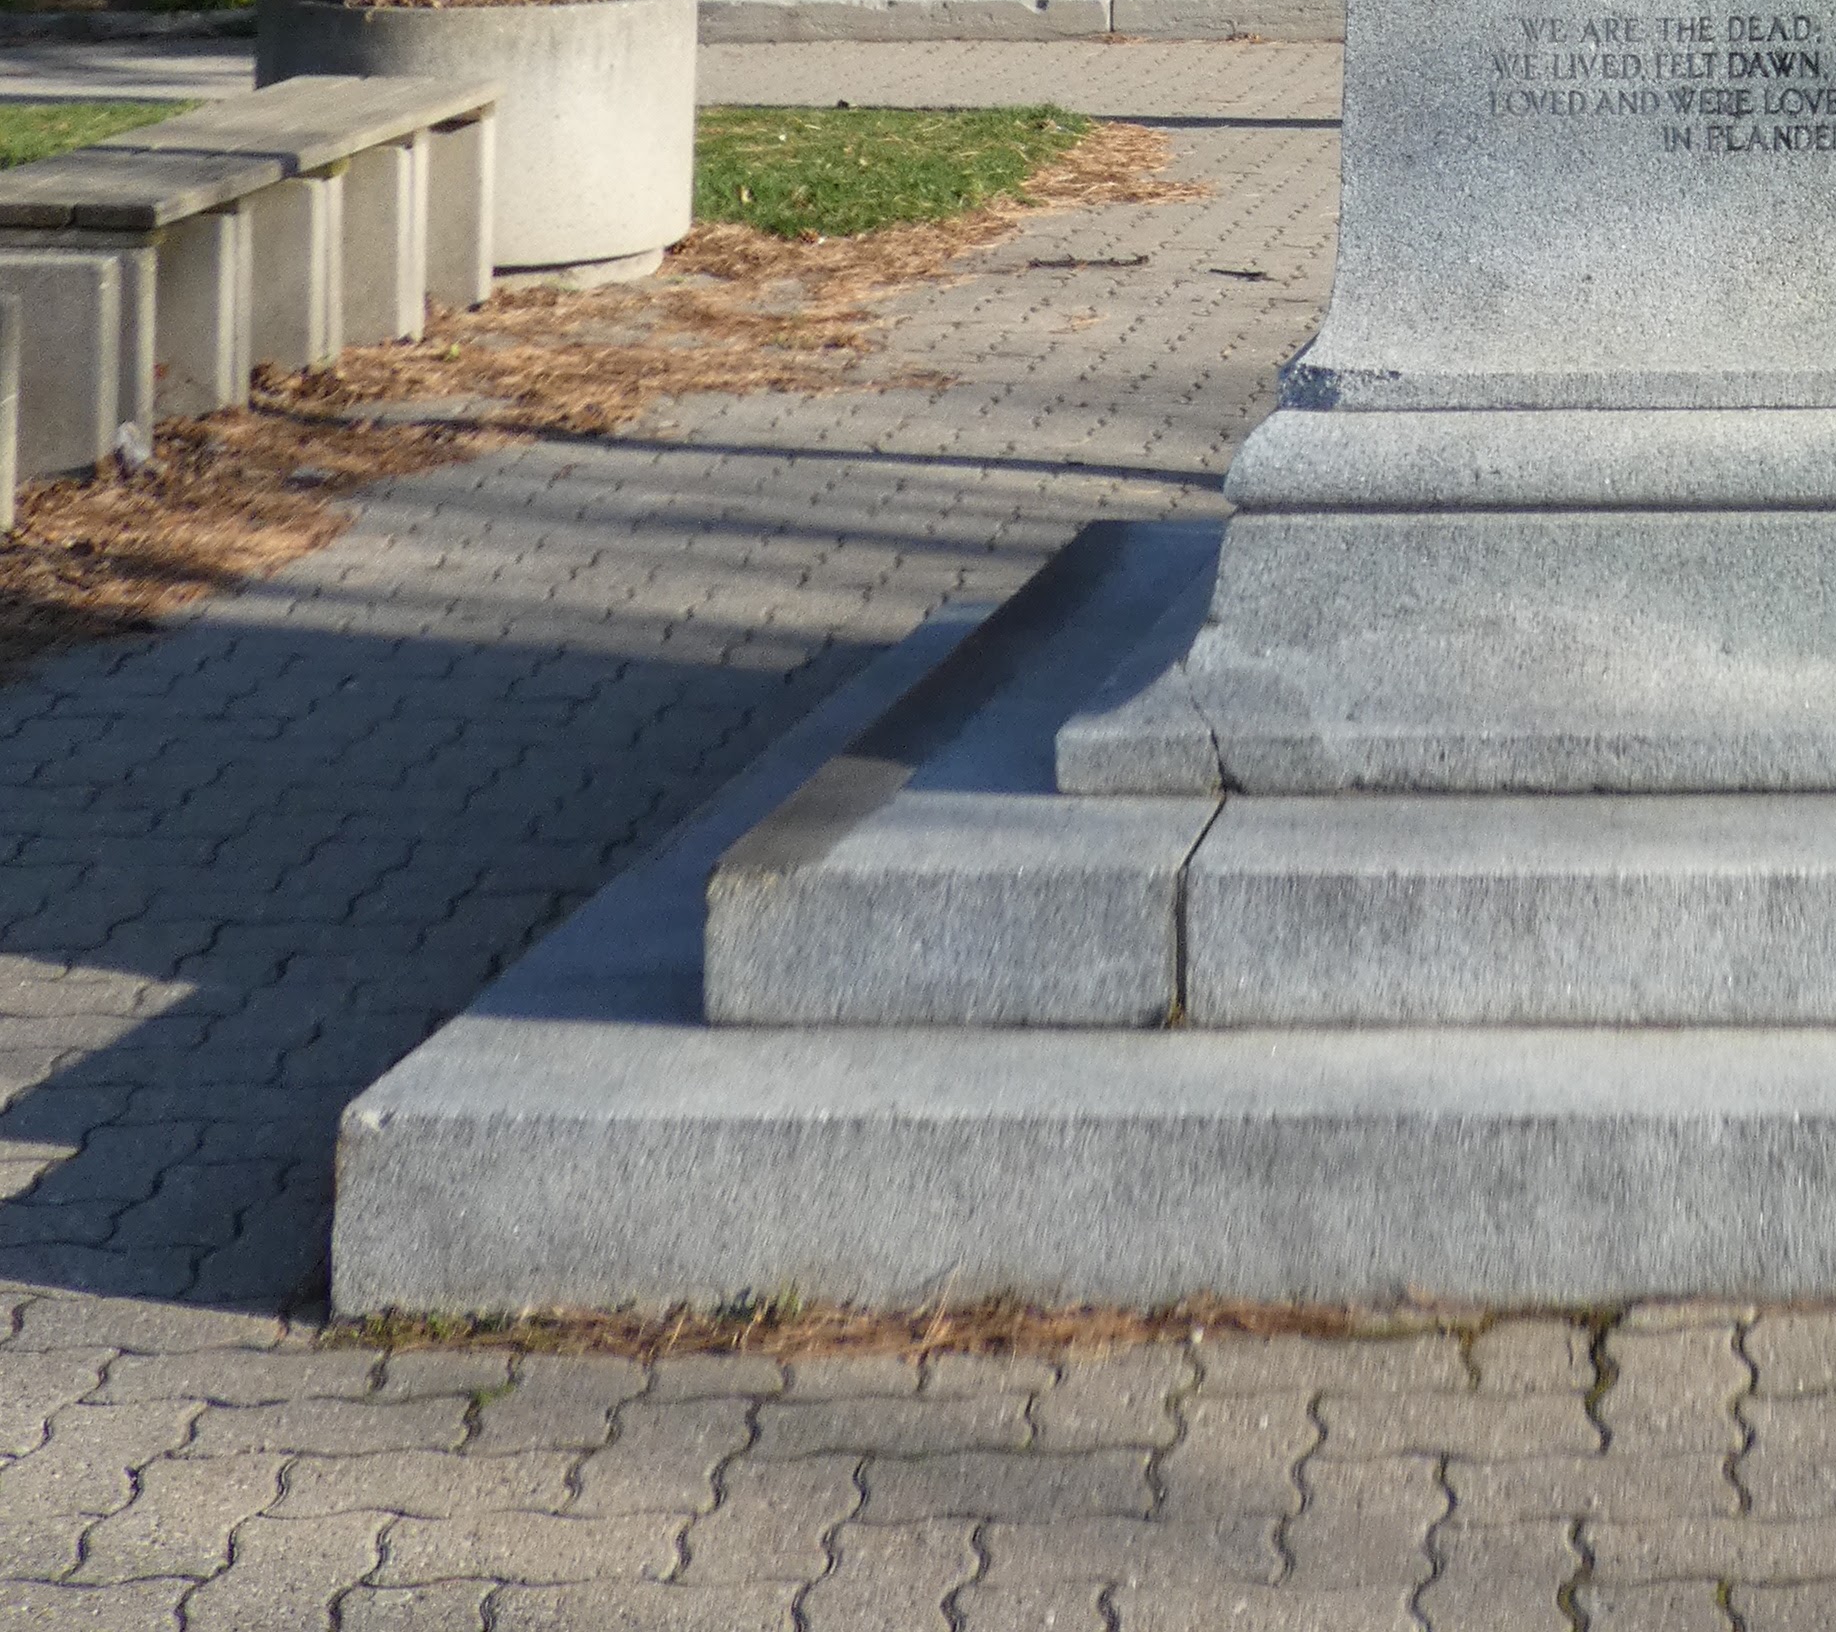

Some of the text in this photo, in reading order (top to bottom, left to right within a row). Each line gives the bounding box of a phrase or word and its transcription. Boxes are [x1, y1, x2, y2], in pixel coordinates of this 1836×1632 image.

[1580, 16, 1645, 46] ARE
[1655, 16, 1717, 43] THE
[1493, 52, 1540, 81] WE
[1655, 52, 1718, 80] FELT
[1488, 88, 1588, 117] LOVED
[1594, 89, 1661, 116] AND
[1666, 87, 1754, 118] WERE
[1662, 124, 1693, 153] IN
